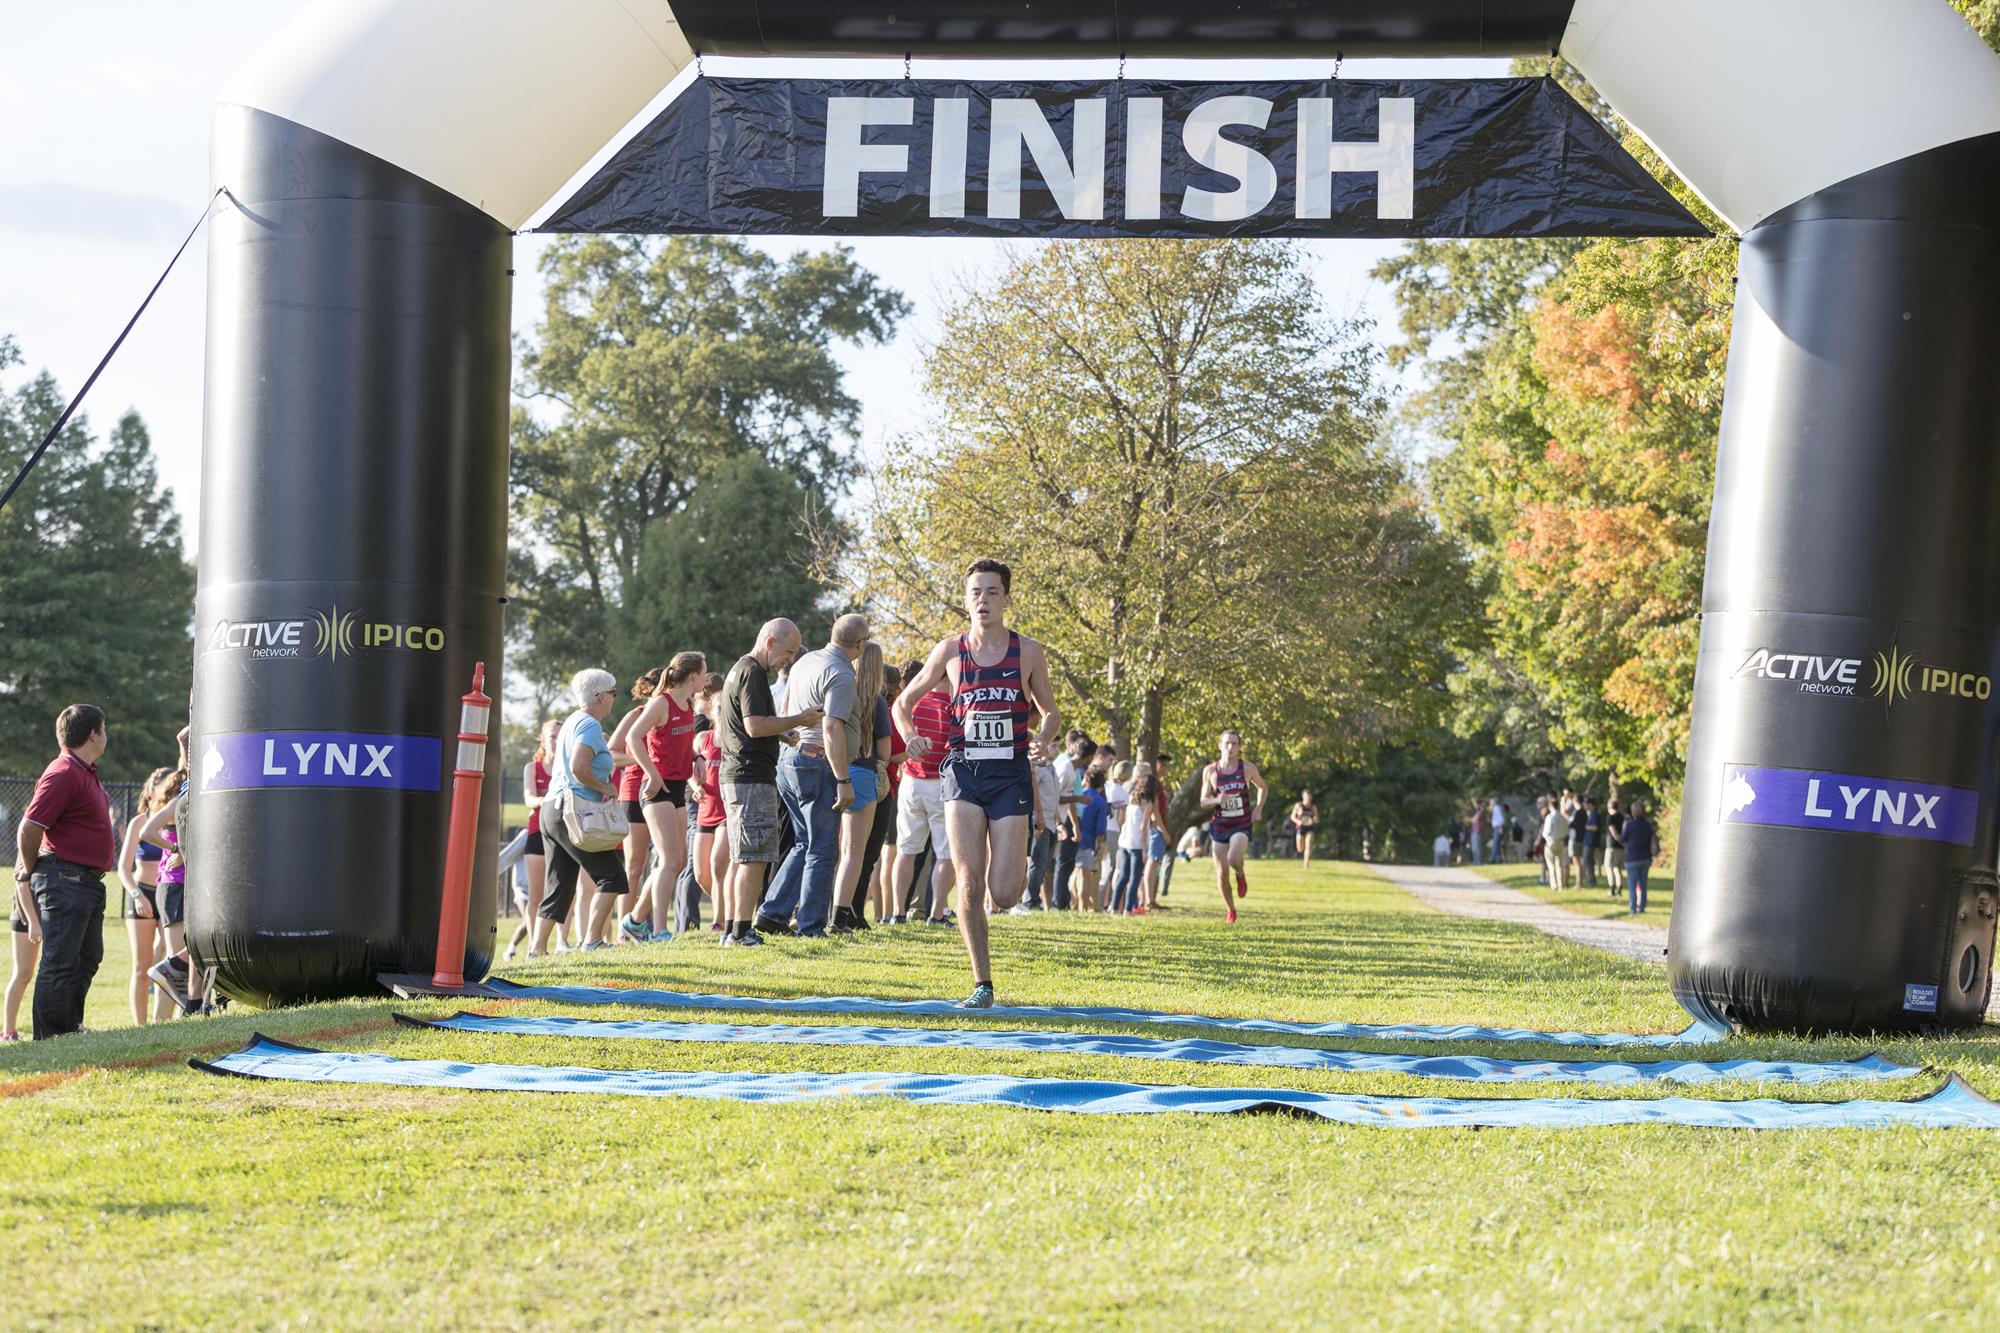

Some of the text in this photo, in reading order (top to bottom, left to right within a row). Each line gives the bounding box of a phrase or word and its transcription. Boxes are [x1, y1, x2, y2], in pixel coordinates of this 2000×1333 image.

[822, 95, 1415, 222] FINISH
[207, 619, 304, 649] ACTIVE
[363, 623, 446, 651] IPICO
[252, 647, 299, 658] network
[1731, 646, 1863, 684] ACTIVE
[960, 687, 1019, 705] PENN
[1799, 682, 1855, 696] network
[1921, 667, 1992, 701] IPICO
[974, 722, 1004, 740] 110
[262, 738, 395, 778] LYNX
[1804, 778, 1942, 830] LYNX
